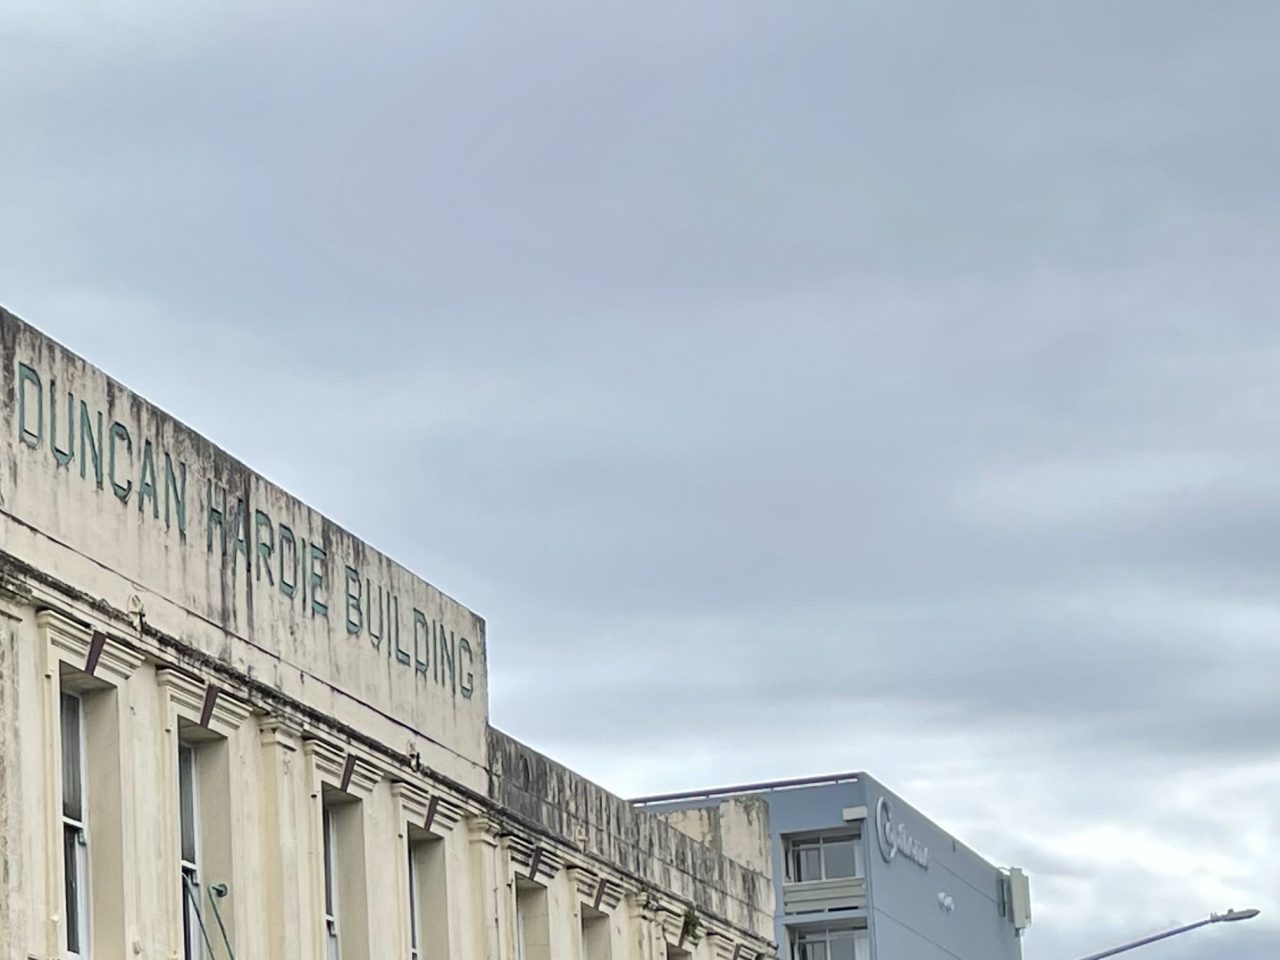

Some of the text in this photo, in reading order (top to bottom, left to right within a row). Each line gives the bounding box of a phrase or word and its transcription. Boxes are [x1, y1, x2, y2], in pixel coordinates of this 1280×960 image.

[18, 361, 474, 699] DUNCAN HARDIE BUILDING
